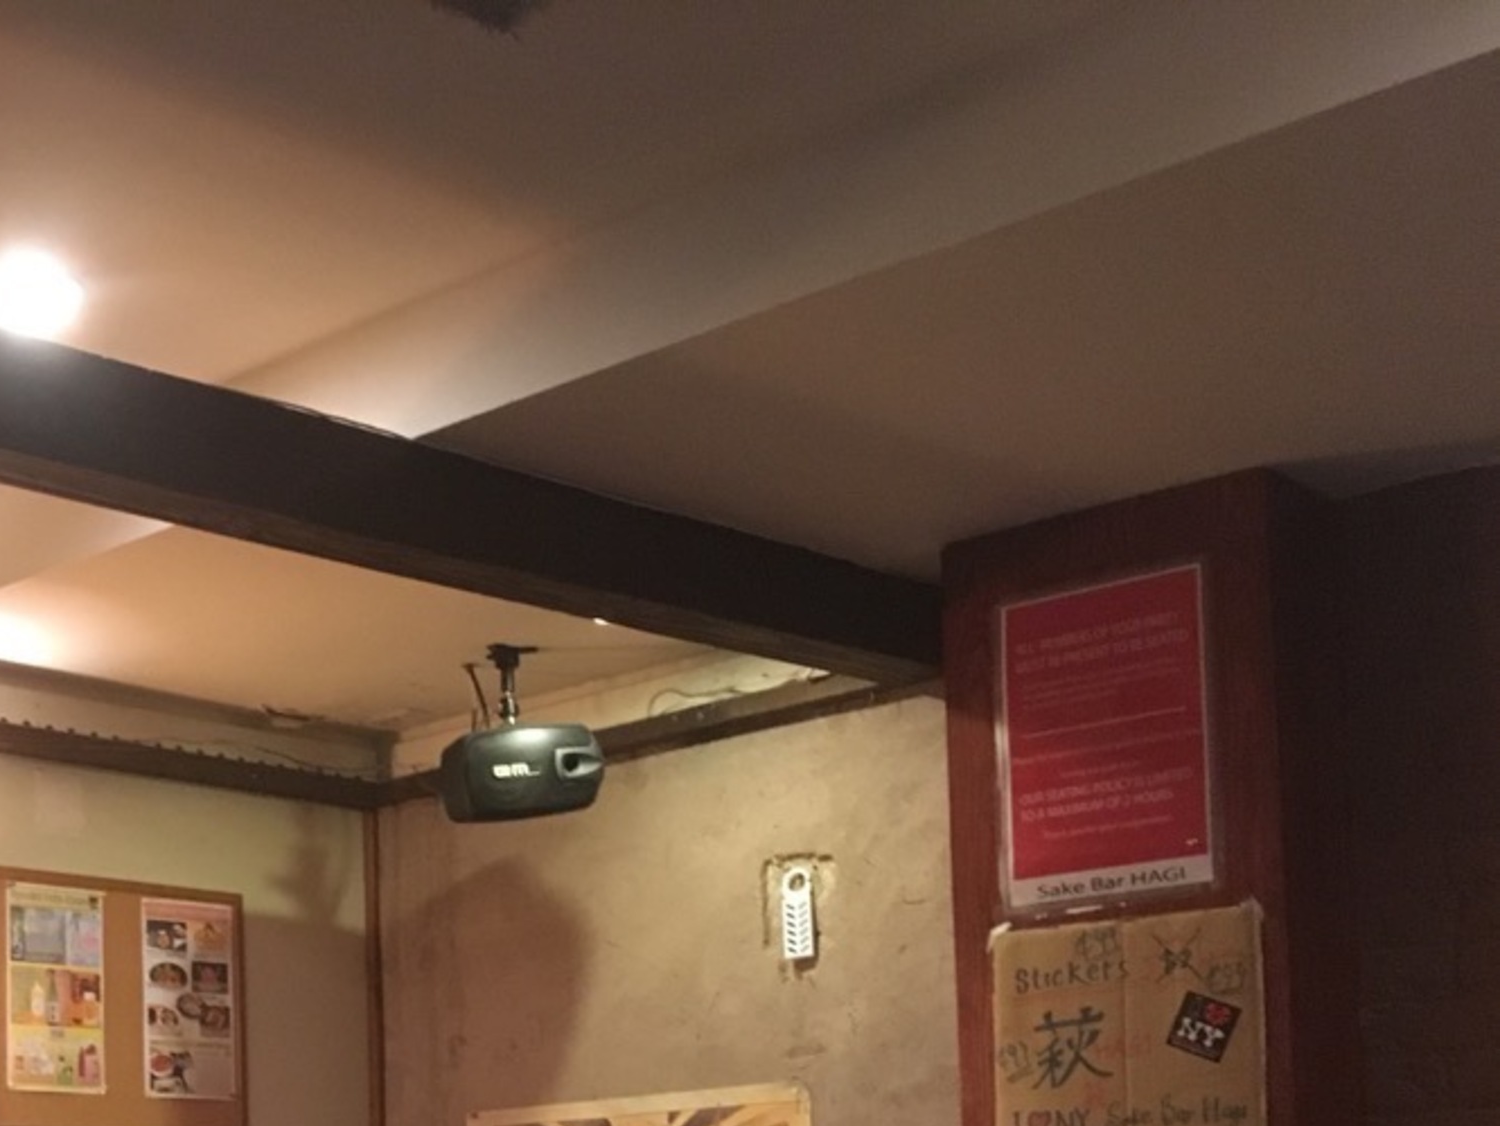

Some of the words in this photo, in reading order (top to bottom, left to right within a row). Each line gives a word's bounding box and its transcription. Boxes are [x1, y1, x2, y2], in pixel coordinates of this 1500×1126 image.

[1037, 882, 1085, 898] Sake
[1090, 876, 1125, 891] Bar
[1130, 866, 1186, 885] HAGI
[1014, 961, 1130, 995] Stickers
